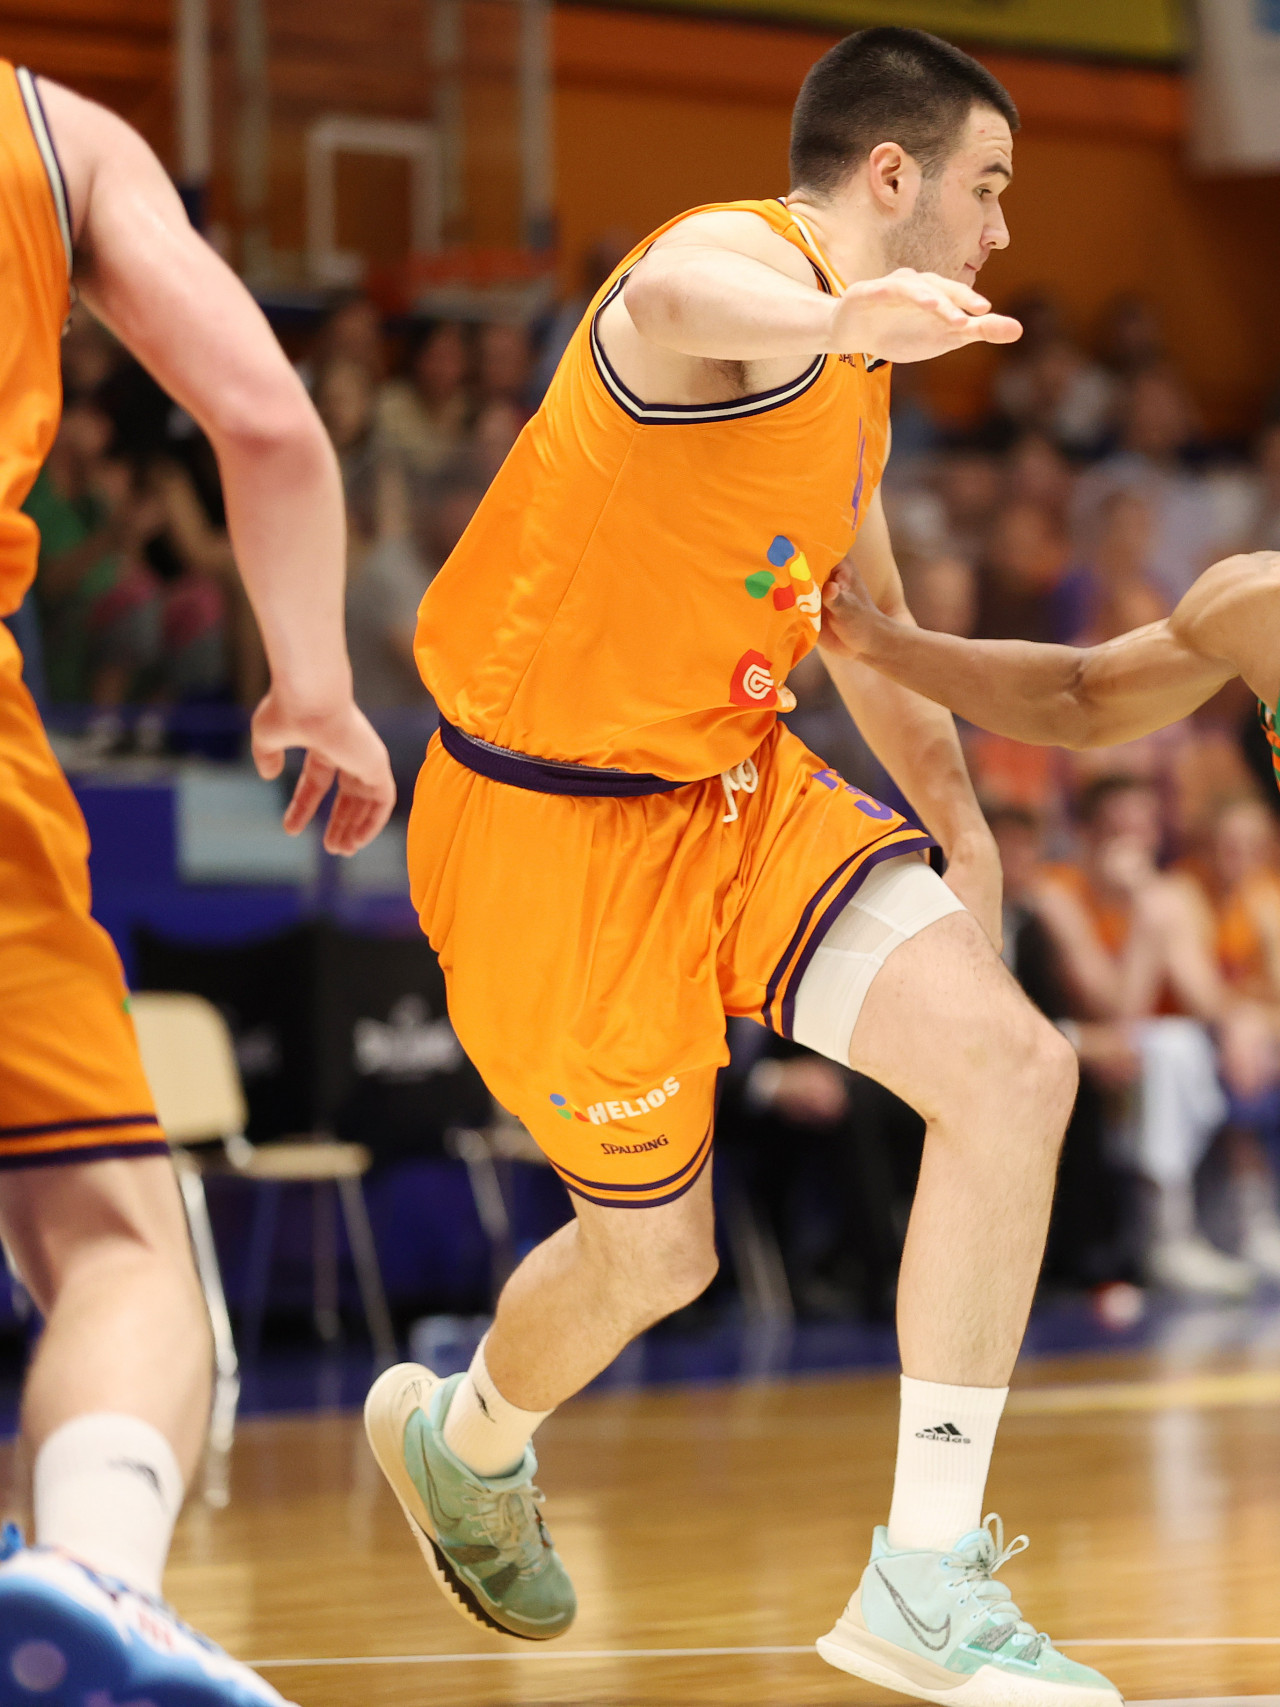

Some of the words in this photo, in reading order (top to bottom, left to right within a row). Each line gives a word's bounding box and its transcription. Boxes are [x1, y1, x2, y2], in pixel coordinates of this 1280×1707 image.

[586, 1076, 681, 1126] HELIOS
[600, 1134, 670, 1155] SPALDING
[915, 1432, 972, 1444] adidas
